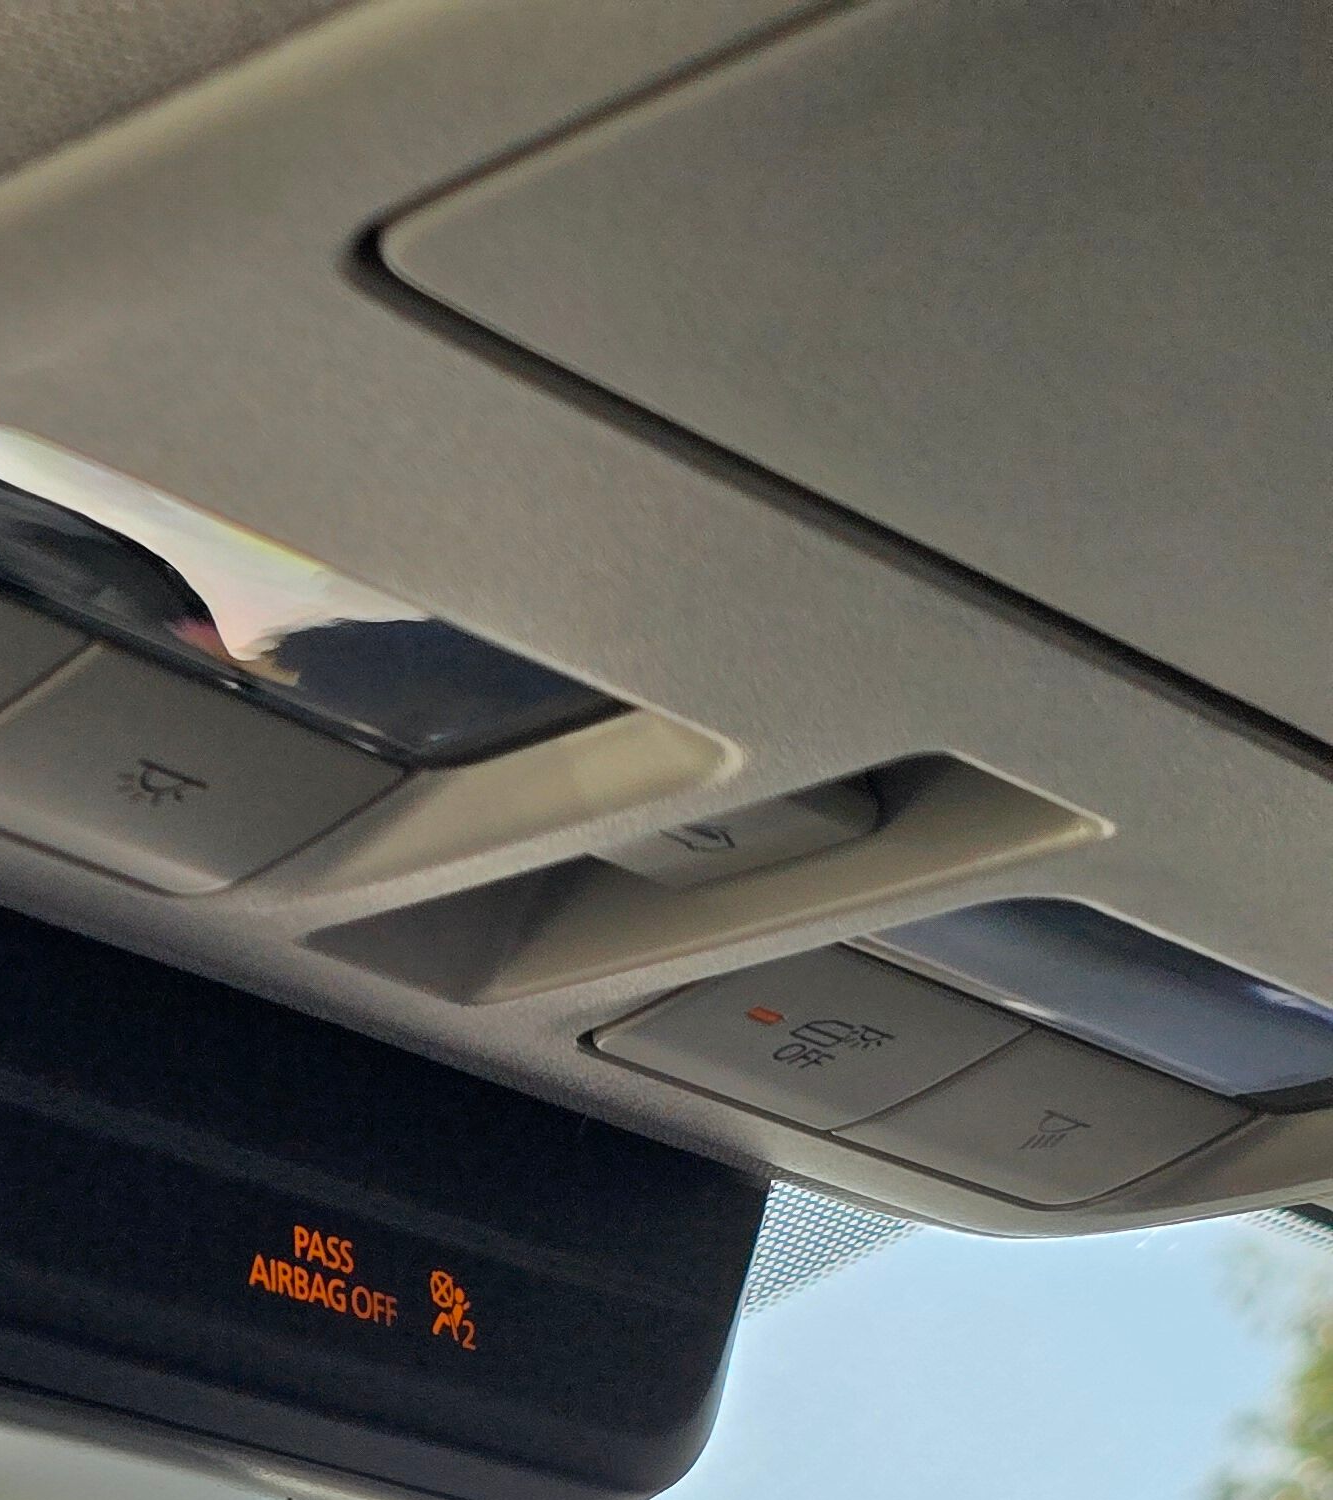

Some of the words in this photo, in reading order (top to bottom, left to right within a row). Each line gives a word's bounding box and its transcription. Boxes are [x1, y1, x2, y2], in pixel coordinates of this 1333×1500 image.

[772, 1043, 837, 1069] OFF
[293, 1224, 355, 1275] PASS
[248, 1253, 347, 1314] AIRBAG
[350, 1285, 398, 1327] OFF
[461, 1319, 477, 1351] 2
